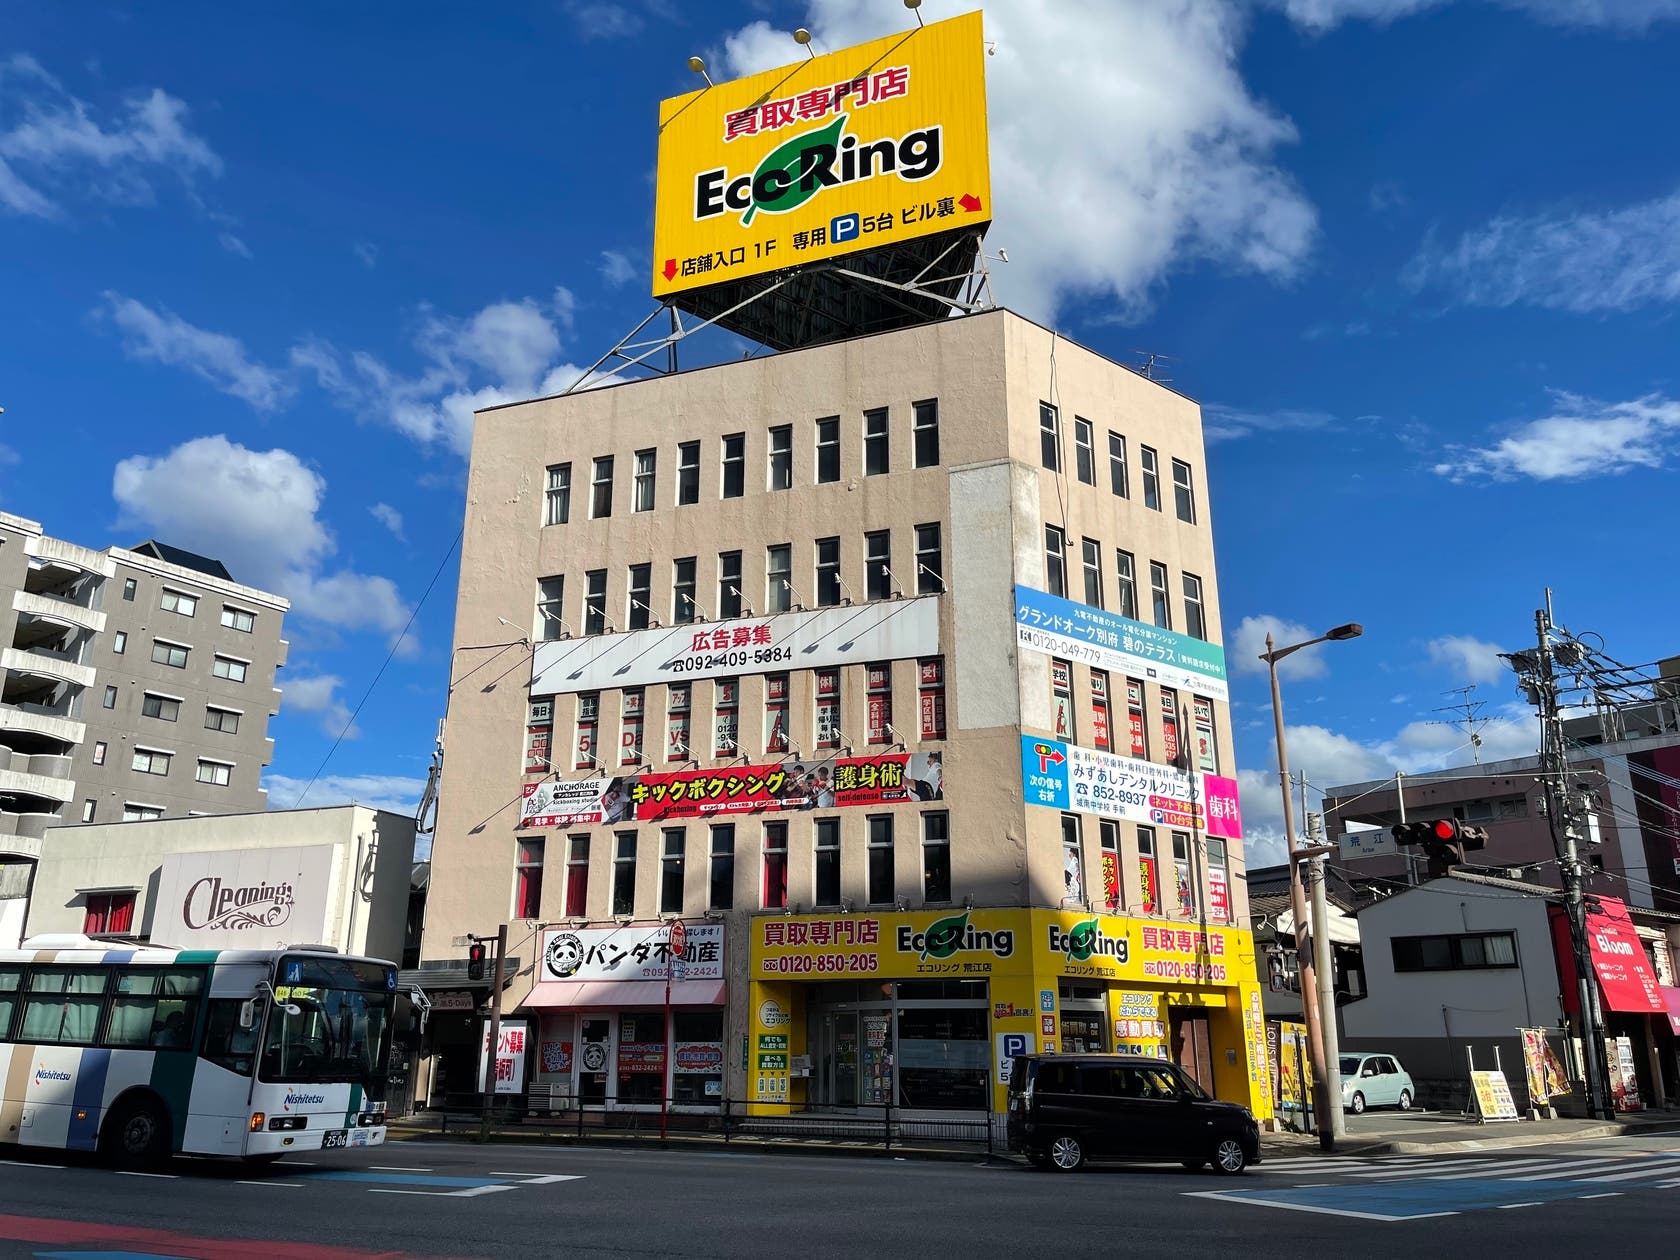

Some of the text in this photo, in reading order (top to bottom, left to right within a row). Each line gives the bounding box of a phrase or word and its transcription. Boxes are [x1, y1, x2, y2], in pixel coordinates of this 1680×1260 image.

[725, 66, 908, 141] 買取専門店
[696, 128, 940, 218] EcoRing
[681, 247, 744, 276] 店舗入口
[754, 240, 776, 258] 1F
[793, 227, 825, 250] 専用
[863, 213, 893, 234] 5台
[902, 197, 955, 224] ビル裏
[691, 625, 771, 652] 広告募集
[1019, 605, 1176, 663] グランドオーク別府 碧のテラス
[1033, 630, 1100, 663] 0120-049-779
[685, 647, 792, 672] 092-409-5384
[1053, 669, 1066, 682] 学校
[718, 724, 738, 732] 0120
[834, 761, 903, 791] 護身術
[1029, 775, 1062, 791] 次の信号
[1074, 764, 1199, 800] みずあしデンタルクリニック
[553, 782, 599, 792] ANCHORAGE
[632, 772, 786, 803] キックボクシング
[1038, 790, 1055, 803] 右折
[1093, 785, 1146, 806] 852-8937
[1076, 799, 1126, 815] 城南中学校 手前
[1209, 797, 1238, 820] 歯科
[1350, 833, 1384, 847] 荒江
[764, 920, 879, 947] 買取専門店
[897, 924, 1014, 957] EcoRing
[1049, 925, 1129, 963] EcoRing
[1142, 926, 1225, 956] 買取専門店
[1596, 935, 1634, 956] Bloom
[779, 954, 878, 973] 0120-850-205
[917, 963, 992, 973] エコリング 荒江店
[1064, 965, 1095, 976] エコリング
[1156, 960, 1226, 981] 0120-850-205
[1121, 993, 1153, 1005] エコリング
[1115, 1019, 1165, 1038] 感動買取
[1267, 1027, 1276, 1055] LOUIS
[36, 1068, 71, 1082] Nishitetsu
[284, 1093, 325, 1106] Nishitetsu
